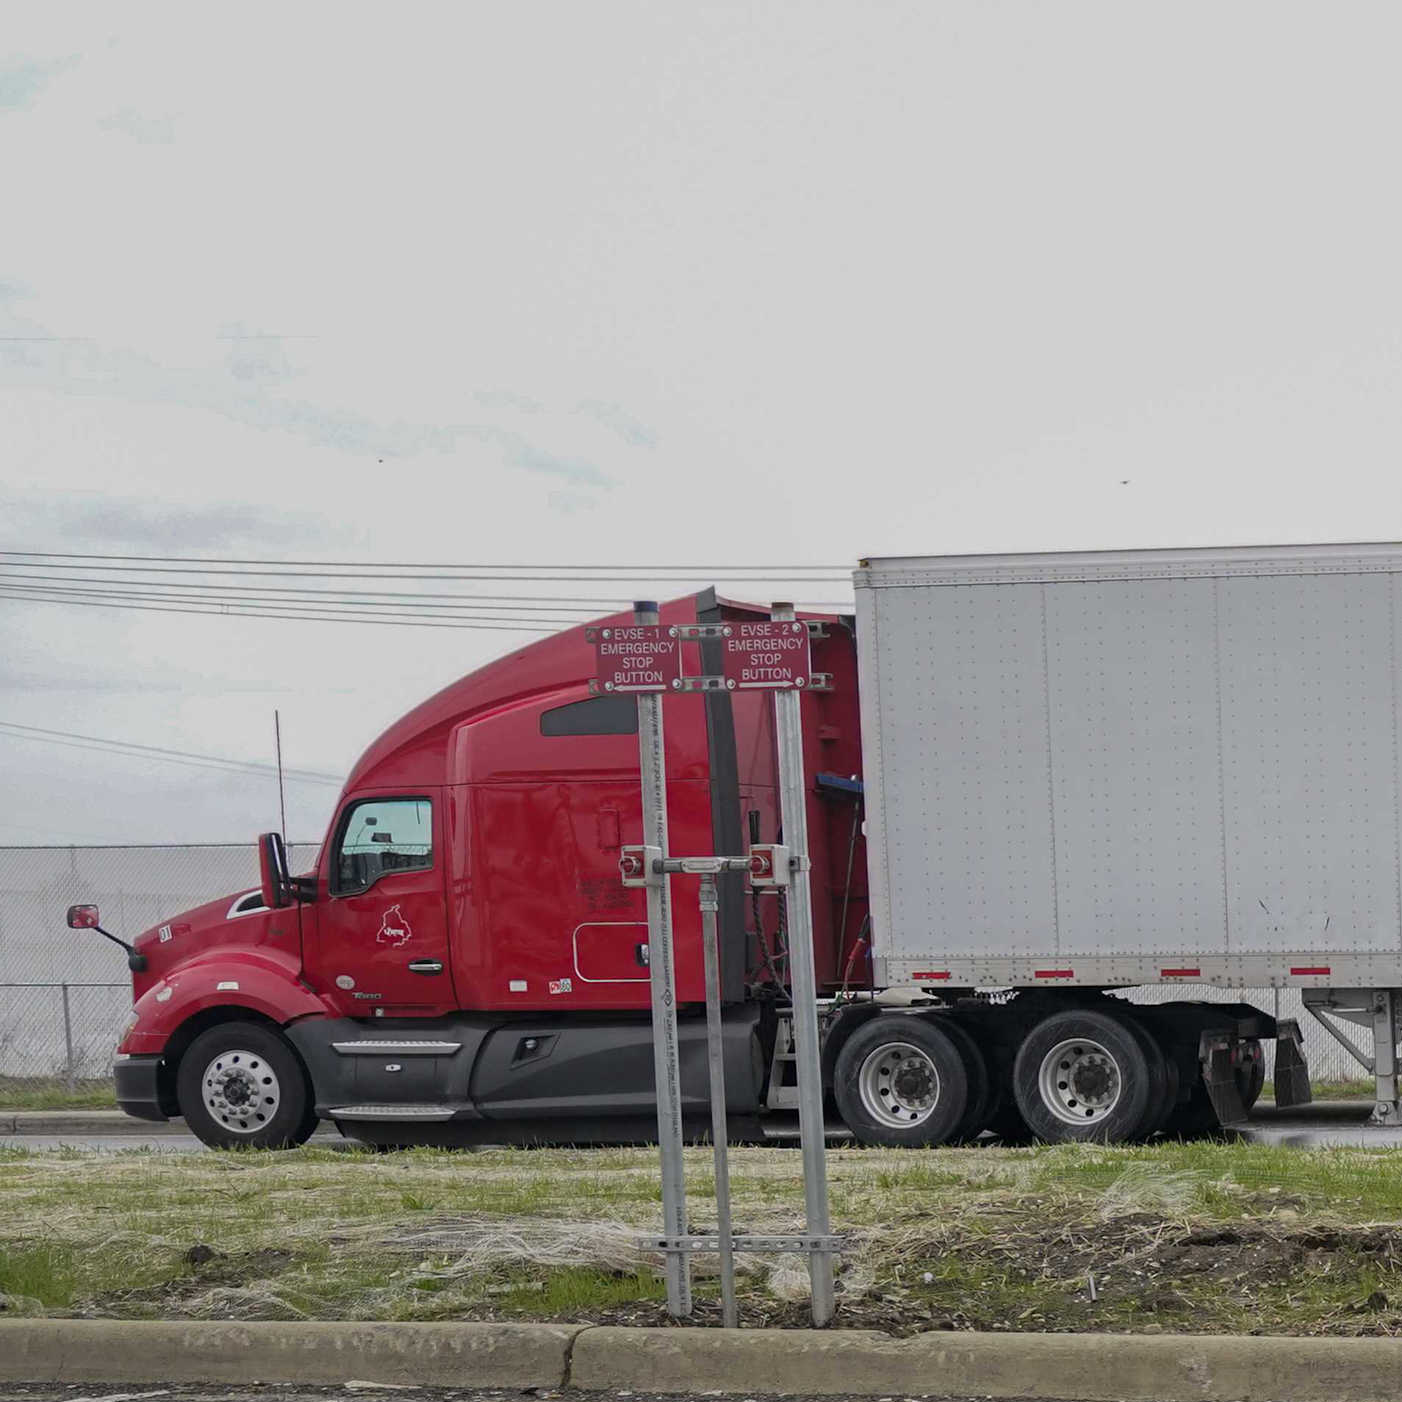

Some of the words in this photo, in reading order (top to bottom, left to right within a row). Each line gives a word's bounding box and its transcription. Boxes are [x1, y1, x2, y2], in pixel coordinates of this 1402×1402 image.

[614, 628, 644, 640] EVSE
[741, 624, 771, 637] EVSE
[782, 624, 790, 636] 2
[600, 641, 675, 655] EMERGENCY
[728, 638, 803, 652] EMERGENCY
[622, 656, 654, 669] STOP
[750, 653, 782, 666] STOP
[614, 671, 663, 684] BUTTON
[742, 668, 792, 680] BUTTON
